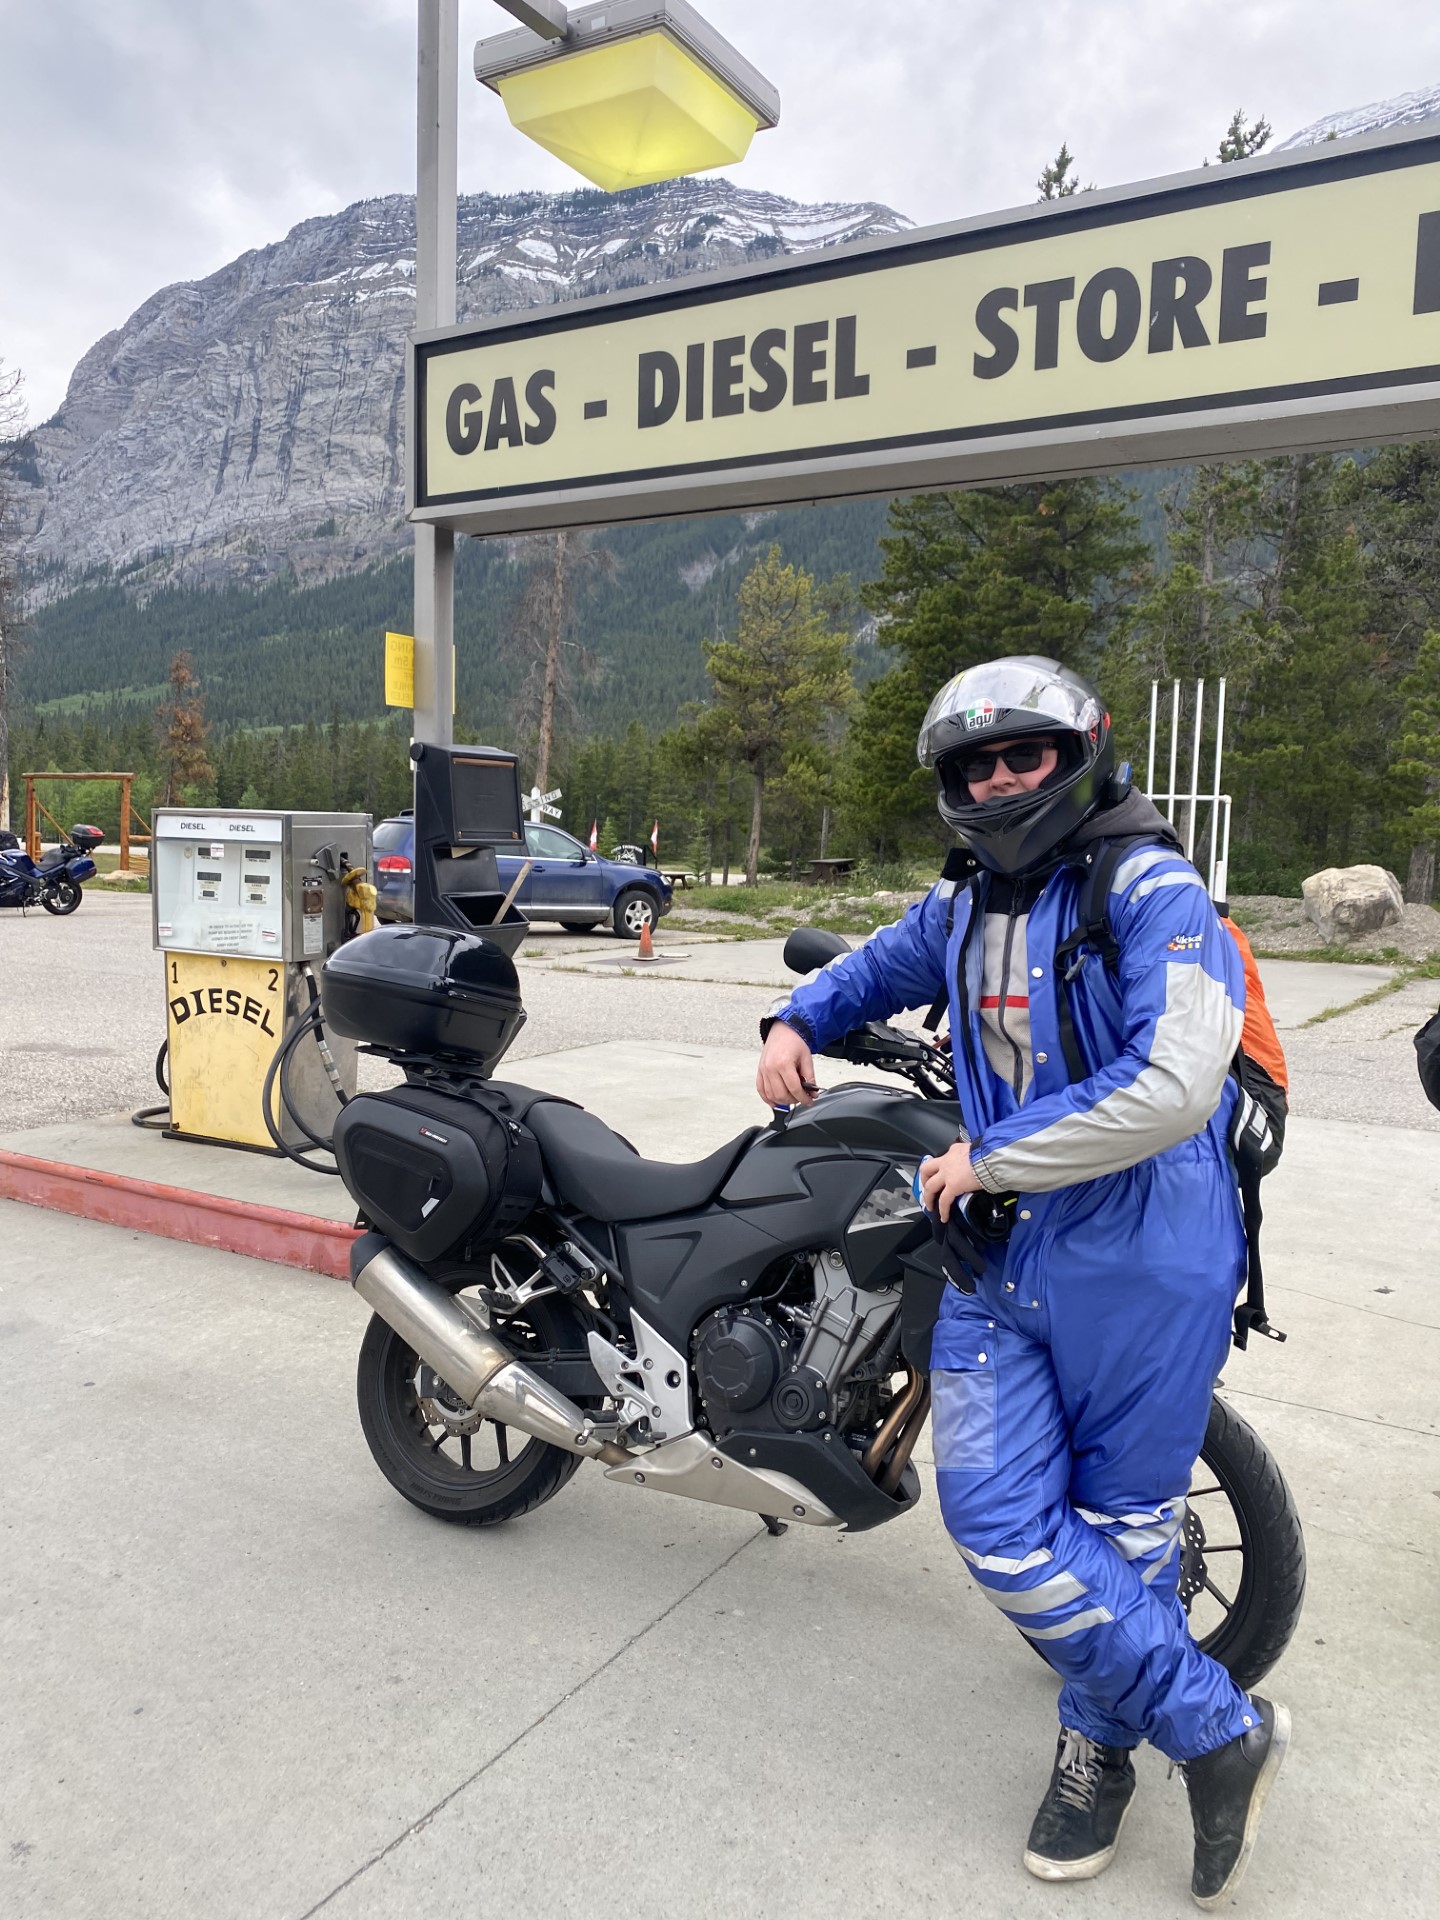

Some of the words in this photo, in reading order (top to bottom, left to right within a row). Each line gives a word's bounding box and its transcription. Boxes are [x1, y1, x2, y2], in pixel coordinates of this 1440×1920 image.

[446, 370, 556, 455] GAS
[638, 315, 869, 428] DIESEL
[974, 241, 1271, 379] STORE
[969, 713, 992, 728] agv
[542, 804, 560, 816] WAY
[180, 822, 206, 830] DIESEL
[229, 824, 256, 832] DIESEL
[1173, 934, 1203, 944] ukka
[171, 961, 179, 984] 1
[267, 968, 279, 992] 2
[169, 988, 275, 1038] DIESEL
